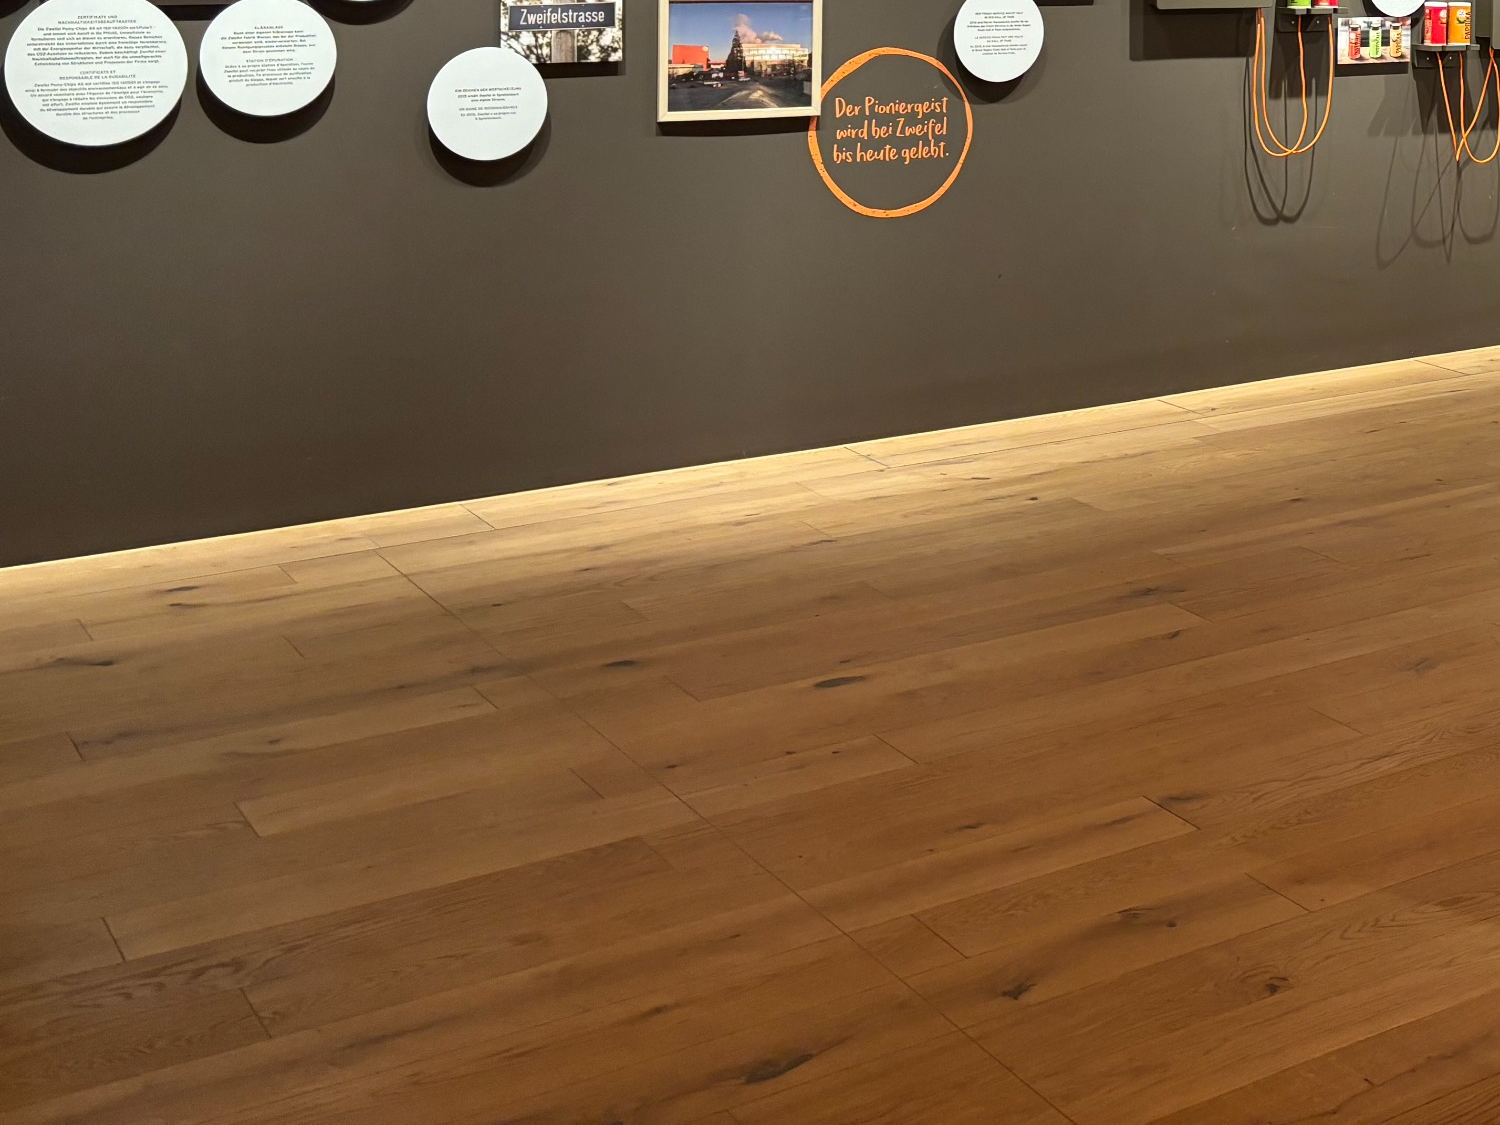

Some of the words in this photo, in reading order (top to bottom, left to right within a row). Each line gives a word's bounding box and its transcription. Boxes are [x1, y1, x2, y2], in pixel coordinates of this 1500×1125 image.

[519, 7, 605, 26] Zweifelstrasse
[834, 97, 863, 116] Der
[864, 95, 948, 121] Pioniergeist
[836, 120, 868, 140] wird
[871, 119, 893, 138] bei
[896, 116, 948, 140] Zweifel
[832, 143, 853, 162] bis
[856, 142, 898, 162] heute
[901, 139, 949, 164] gelebt.
